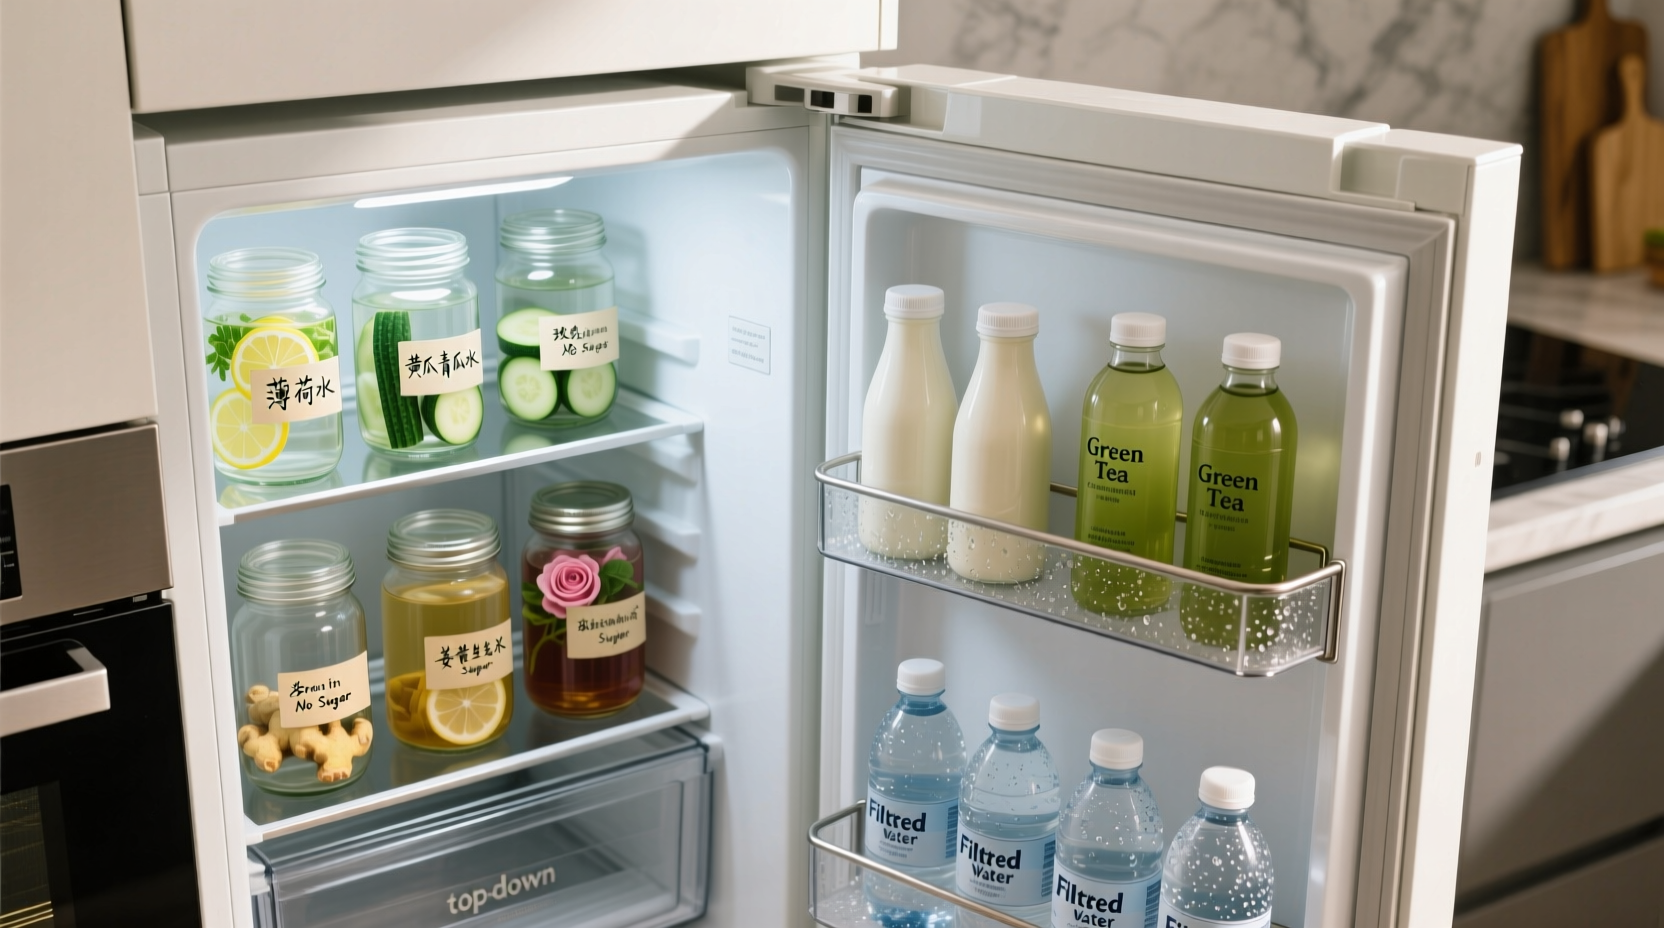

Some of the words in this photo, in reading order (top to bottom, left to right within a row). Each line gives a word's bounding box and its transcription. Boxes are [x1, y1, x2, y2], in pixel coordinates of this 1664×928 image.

[405, 349, 479, 379] 黄瓜青瓜水
[266, 375, 335, 411] 薄荷水
[1087, 437, 1144, 463] Green
[1094, 460, 1129, 484] Tea
[1198, 464, 1258, 491] Green
[1207, 487, 1245, 512] Tea
[295, 699, 313, 713] No
[318, 692, 352, 711] Sugar
[446, 866, 556, 914] top-down
